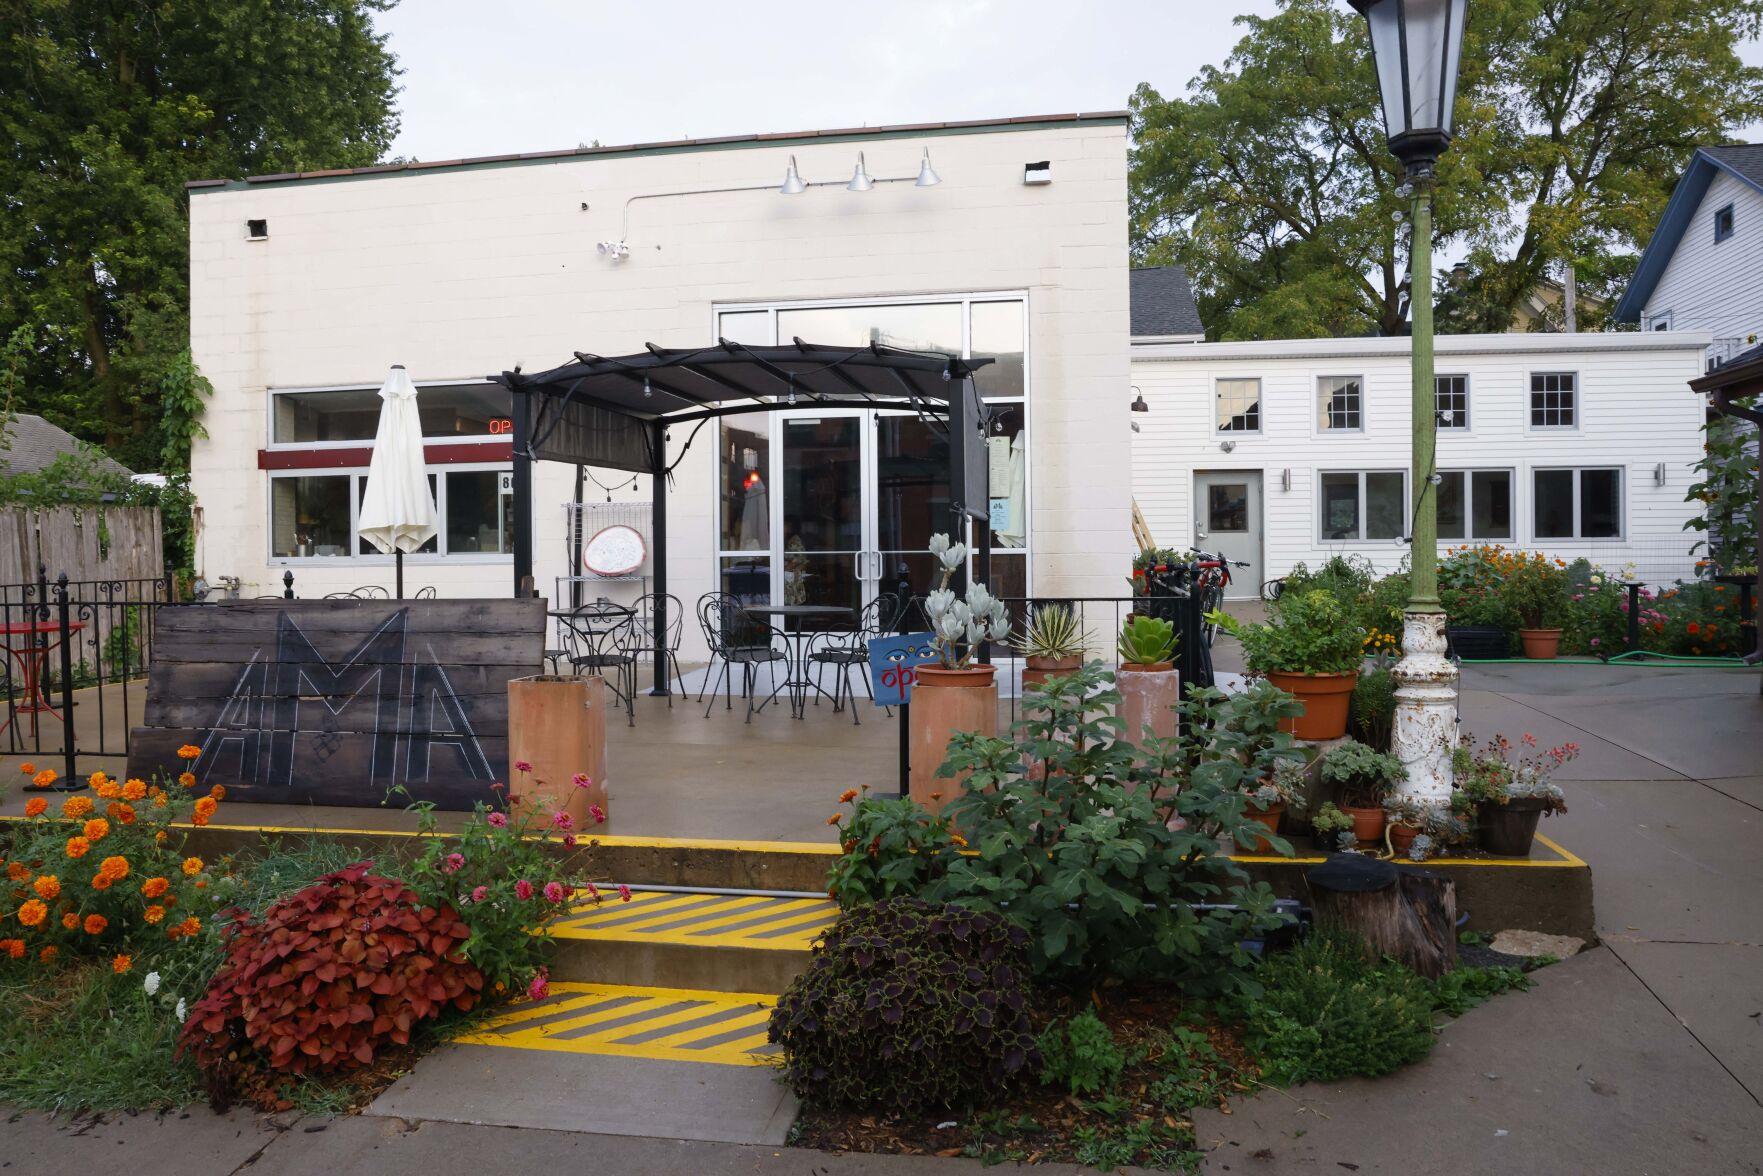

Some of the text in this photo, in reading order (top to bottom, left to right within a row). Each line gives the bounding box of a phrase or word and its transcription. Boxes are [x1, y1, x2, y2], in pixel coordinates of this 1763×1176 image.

[489, 420, 512, 434] OP
[502, 476, 513, 489] 8
[881, 663, 919, 700] op
